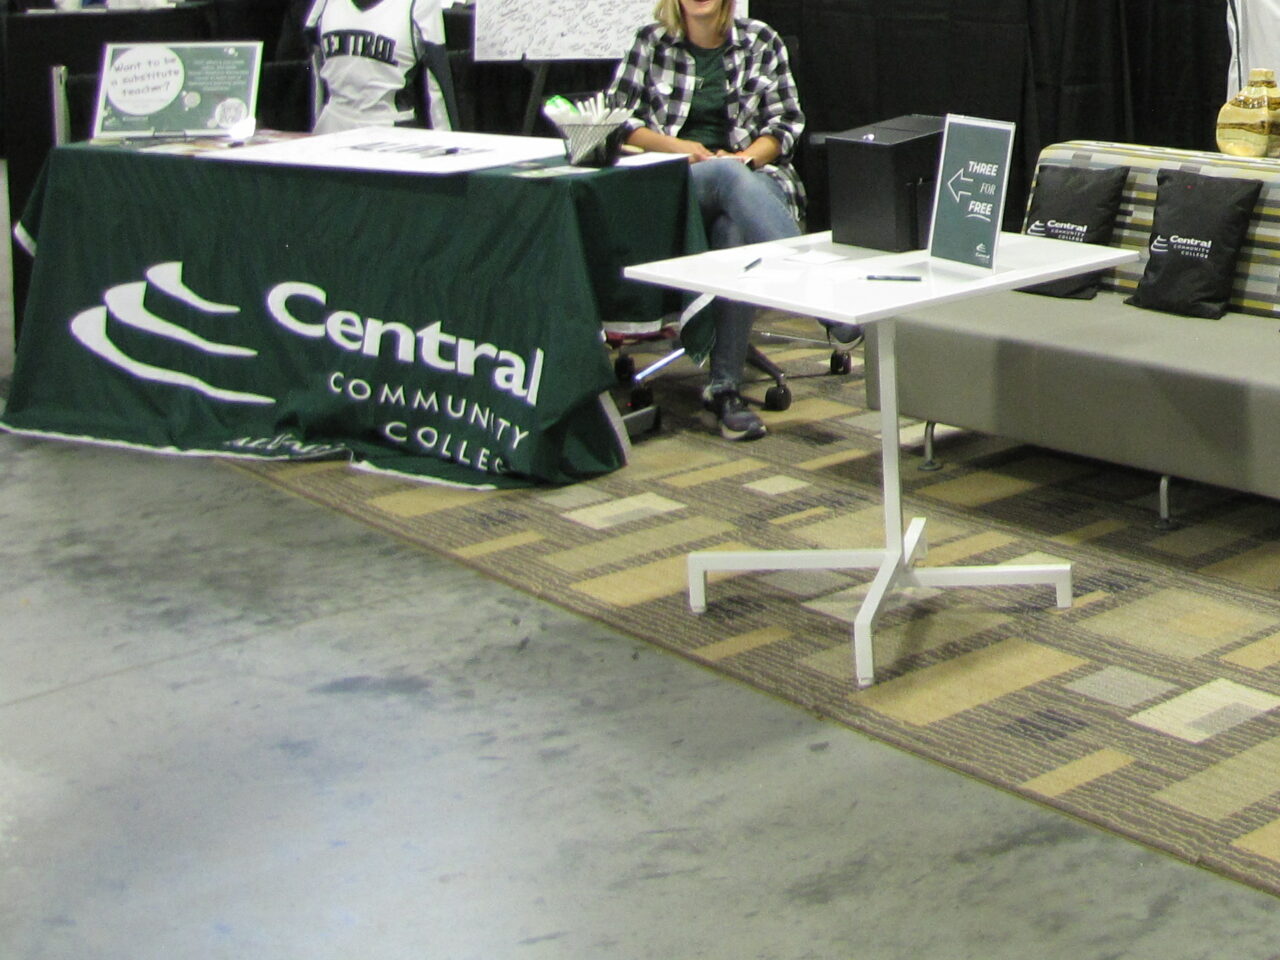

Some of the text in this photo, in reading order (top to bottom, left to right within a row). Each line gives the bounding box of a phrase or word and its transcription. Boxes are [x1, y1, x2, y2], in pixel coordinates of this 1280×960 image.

[112, 55, 177, 73] Want to be
[122, 69, 180, 84] substitute
[122, 81, 170, 97] teacher?
[968, 161, 999, 177] THREE
[979, 182, 996, 196] FOR
[968, 200, 993, 216] FREE
[1047, 220, 1088, 233] Central
[1170, 235, 1213, 249] Central
[266, 281, 546, 407] Central
[329, 371, 531, 451] COMMUNITY
[384, 421, 505, 474] COLLE
